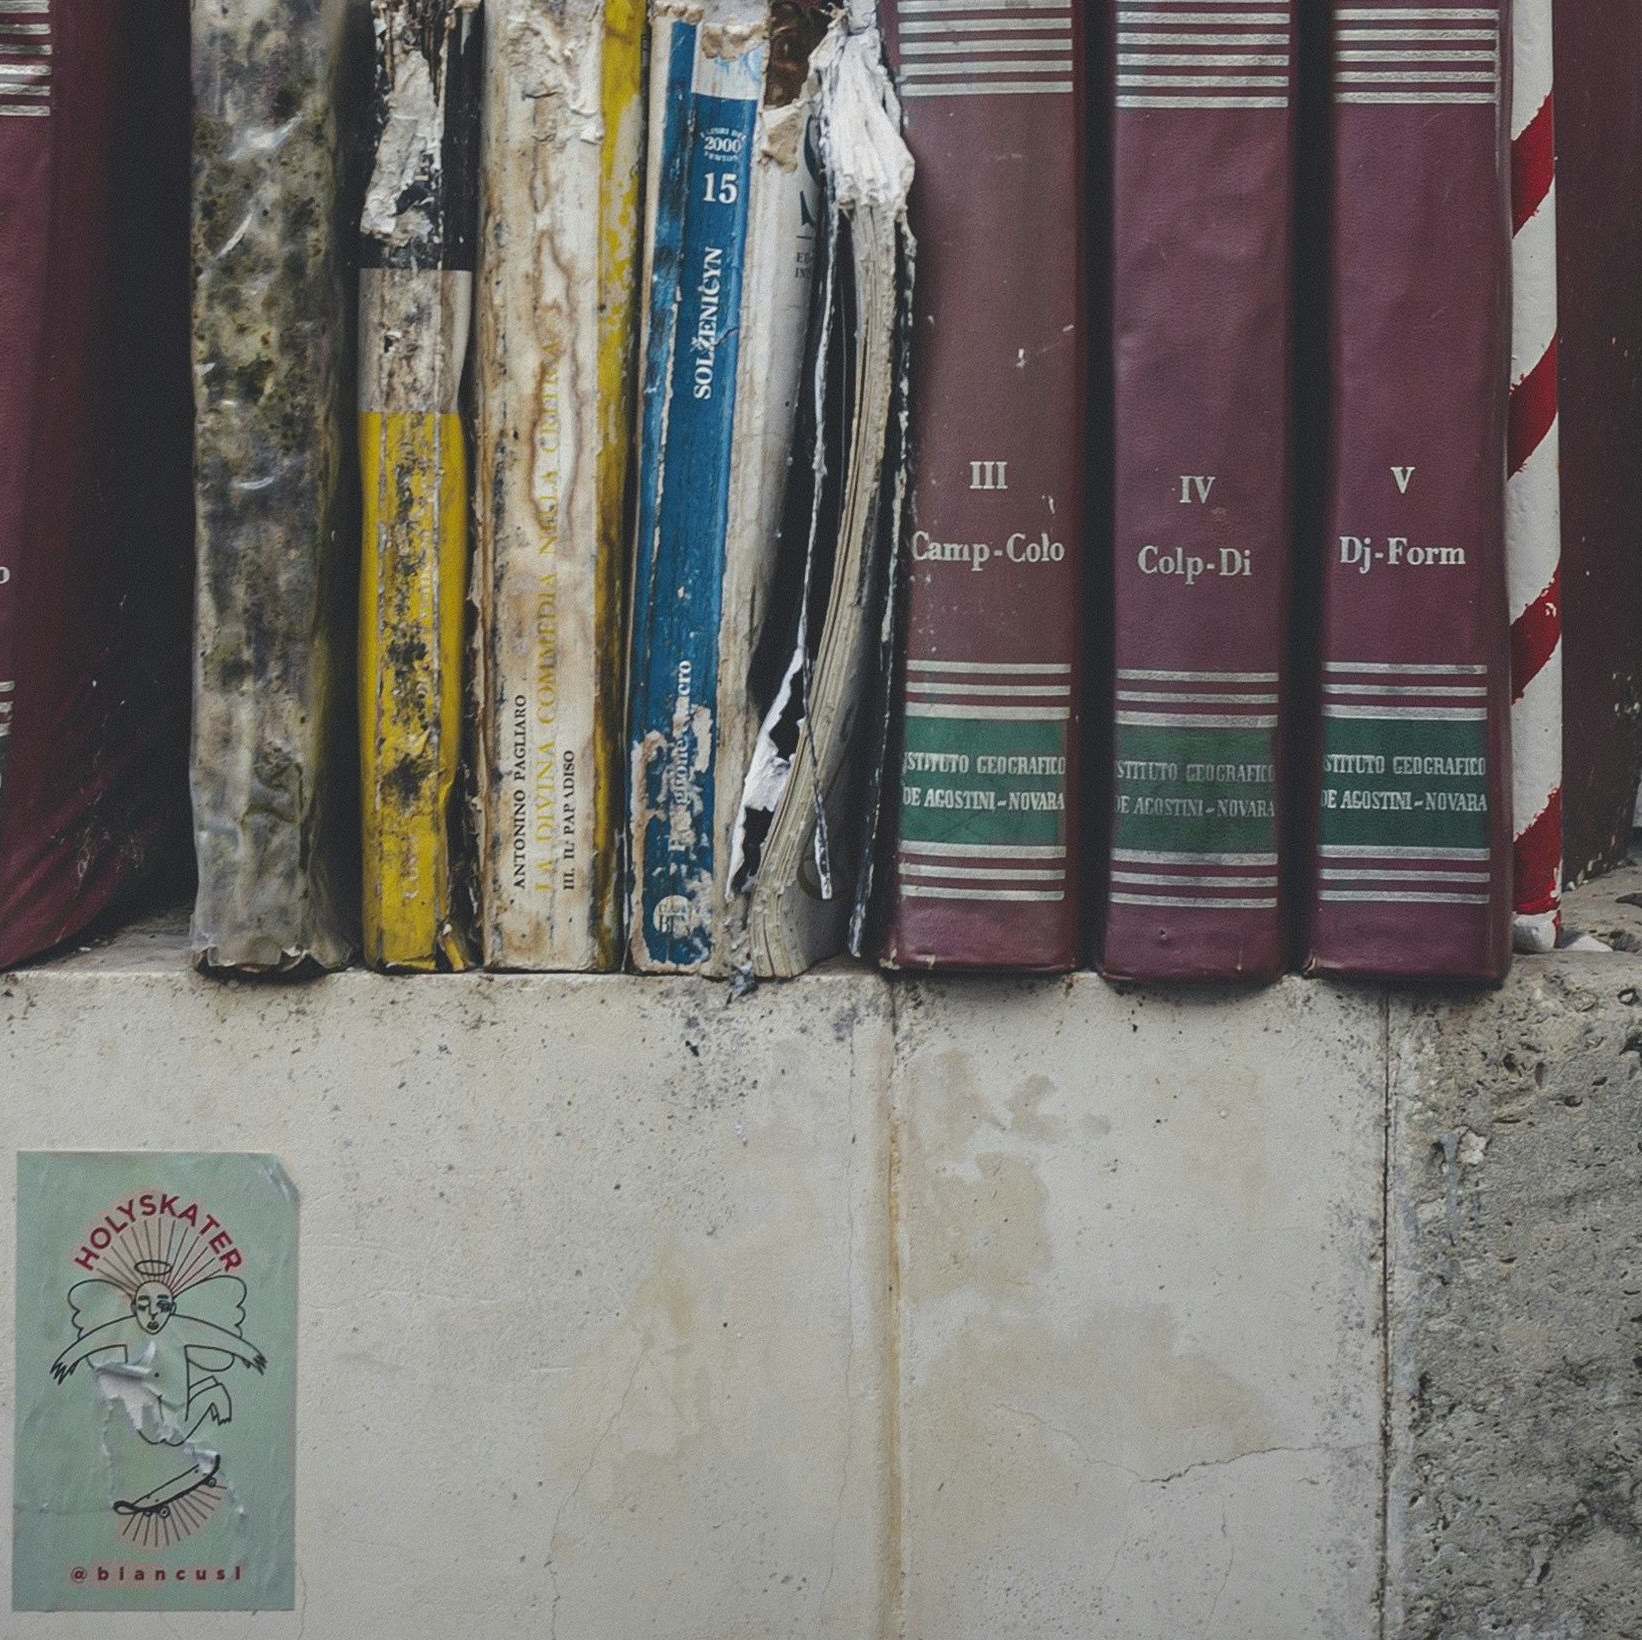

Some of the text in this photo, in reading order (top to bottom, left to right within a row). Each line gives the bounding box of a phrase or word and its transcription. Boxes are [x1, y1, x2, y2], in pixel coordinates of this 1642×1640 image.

[704, 136, 742, 154] 2000
[703, 172, 738, 204] 15
[969, 461, 1008, 490] III
[1179, 475, 1215, 504] IV
[1390, 466, 1415, 494] V
[1137, 546, 1252, 585] Colp-Di
[1339, 536, 1466, 574] Dj-Form
[536, 573, 557, 726] COMMEDIA
[976, 755, 1066, 775] GEOGRAFICO
[1186, 763, 1275, 783] GEOGRAFICO
[1392, 756, 1486, 776] GEOGRAFICO
[513, 694, 528, 890] ANTONINO PAGLIARO
[534, 739, 556, 843] DIVINA
[902, 786, 922, 807] DE
[1320, 789, 1338, 809] DE
[73, 1193, 243, 1271] HOLYSKATER
